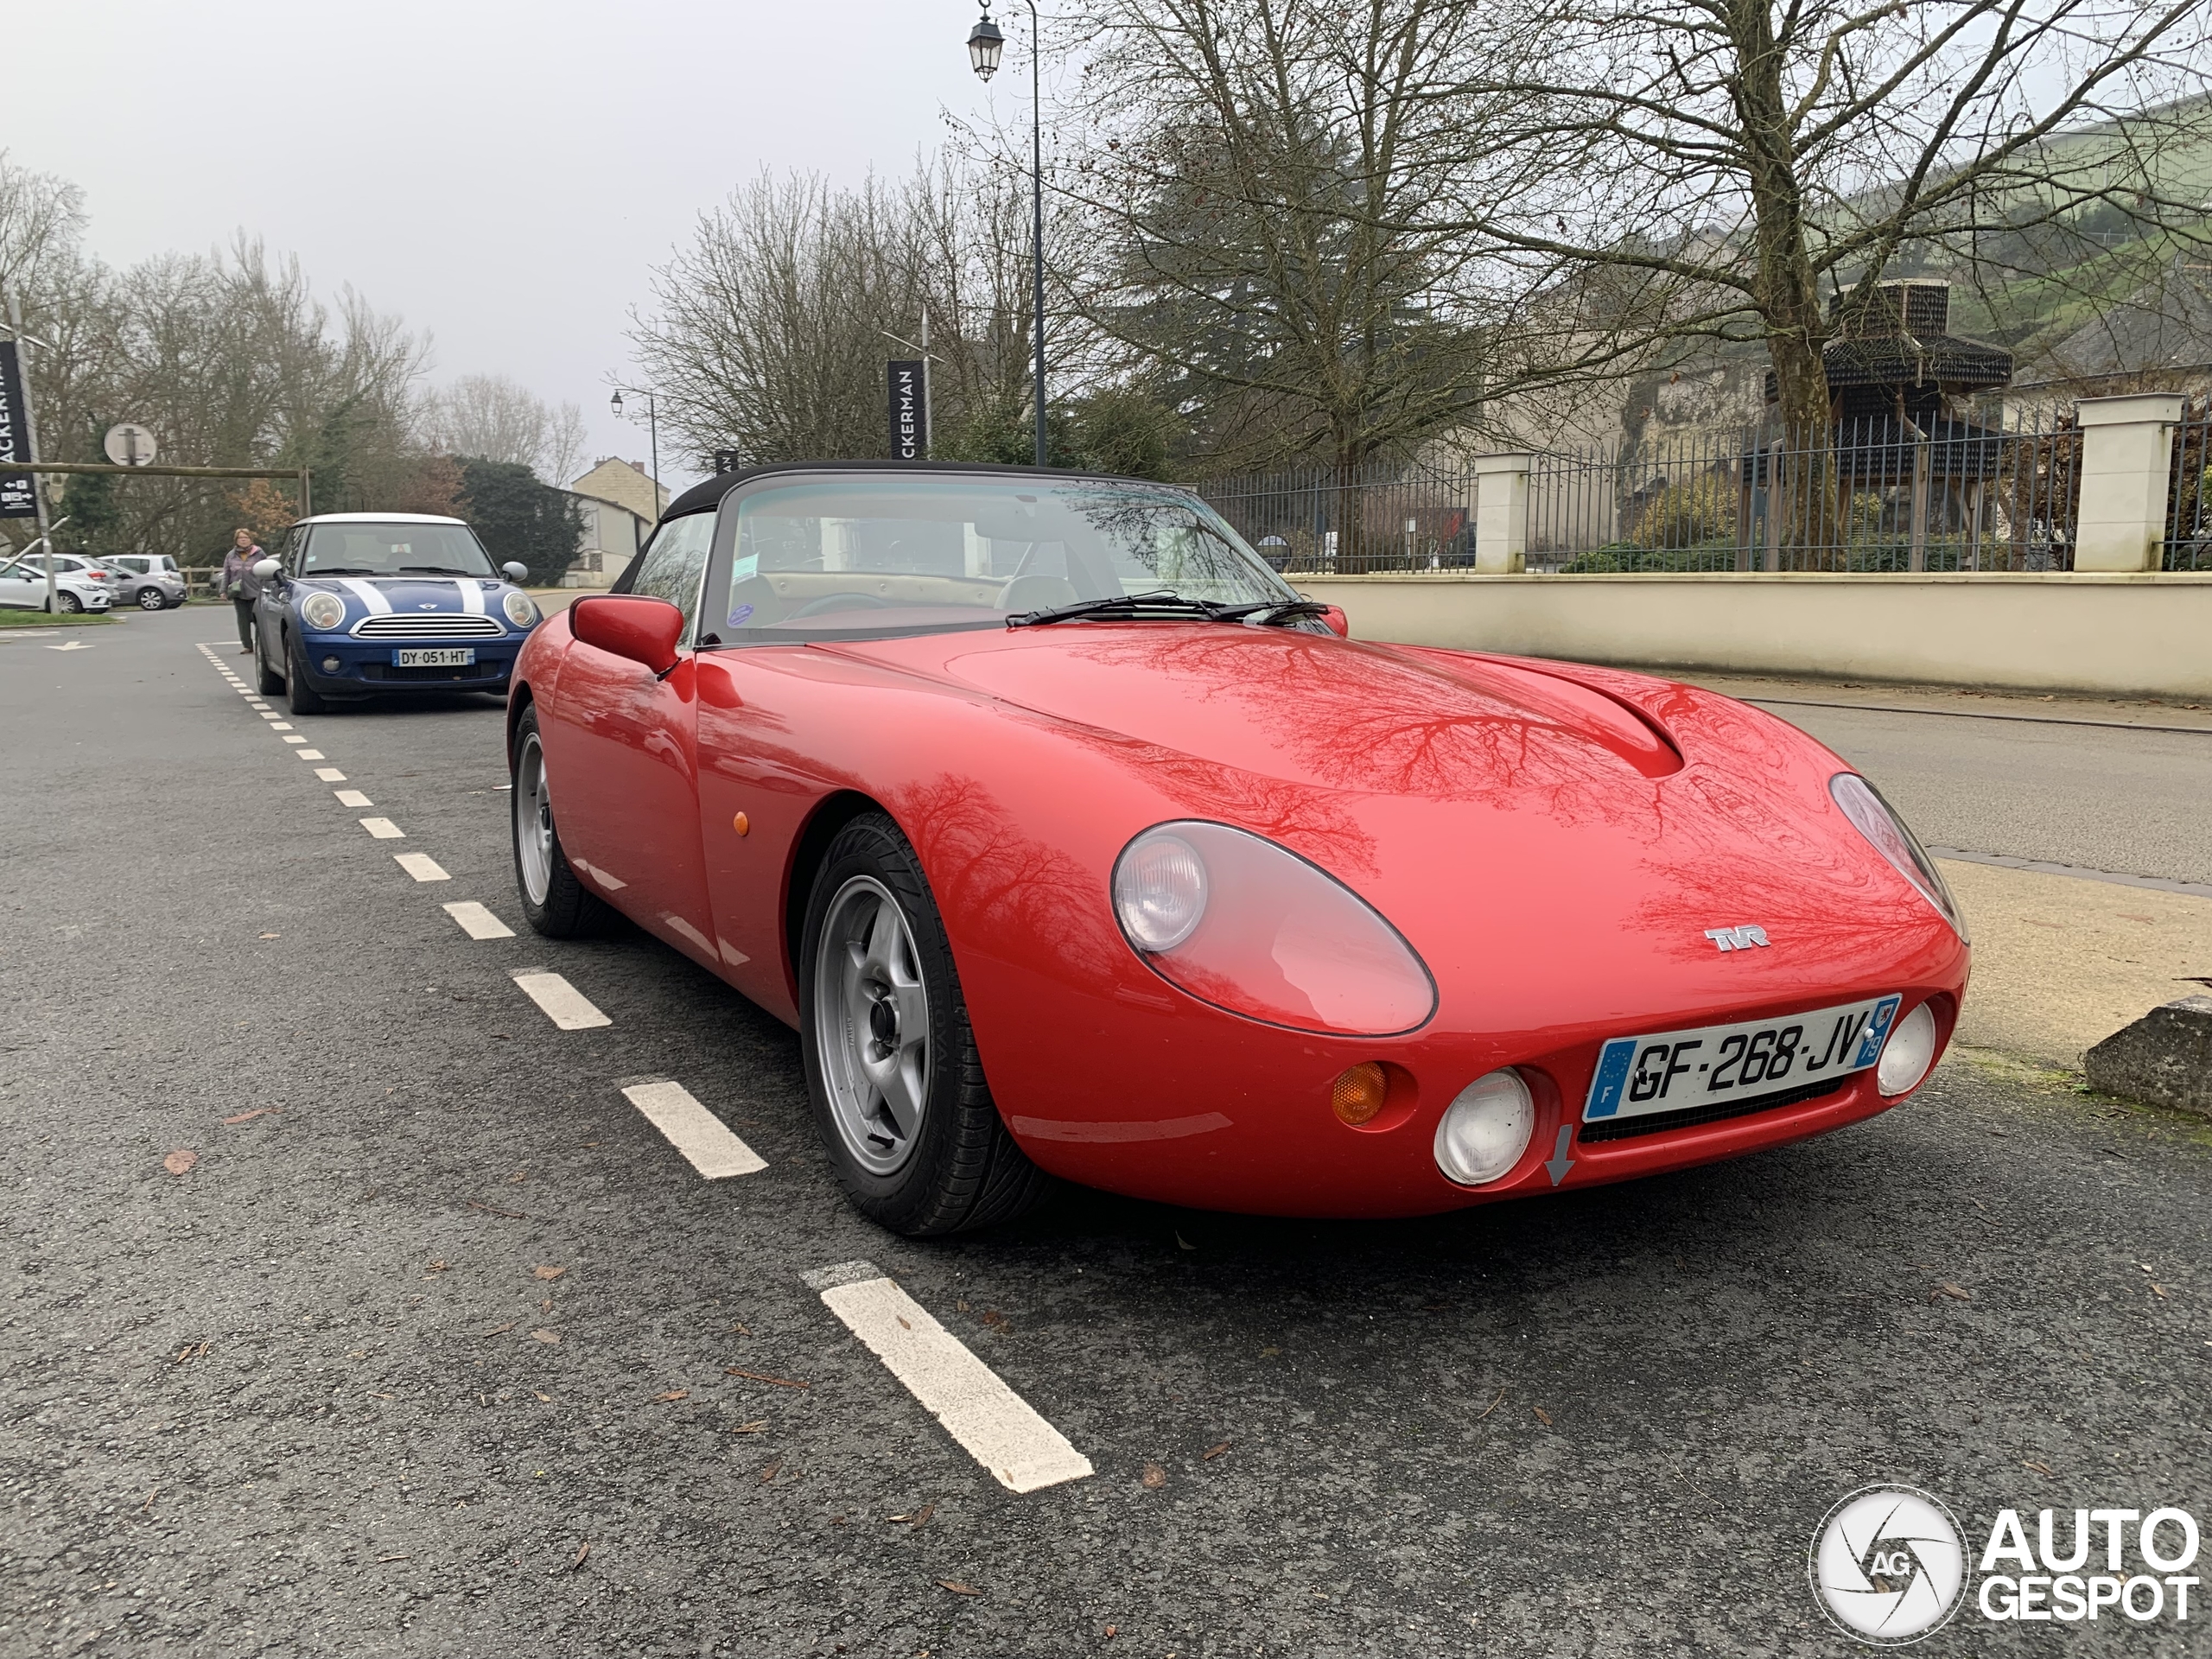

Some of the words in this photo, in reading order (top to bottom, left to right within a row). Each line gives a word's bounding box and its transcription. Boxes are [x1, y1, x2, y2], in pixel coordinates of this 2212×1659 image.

[0, 361, 15, 463] ACKER
[402, 651, 465, 664] DY-051-HT
[1704, 924, 1771, 952] TVR
[1629, 1010, 1869, 1103] GF-268-JV
[1860, 1035, 1881, 1059] 79
[1601, 1085, 1613, 1103] F
